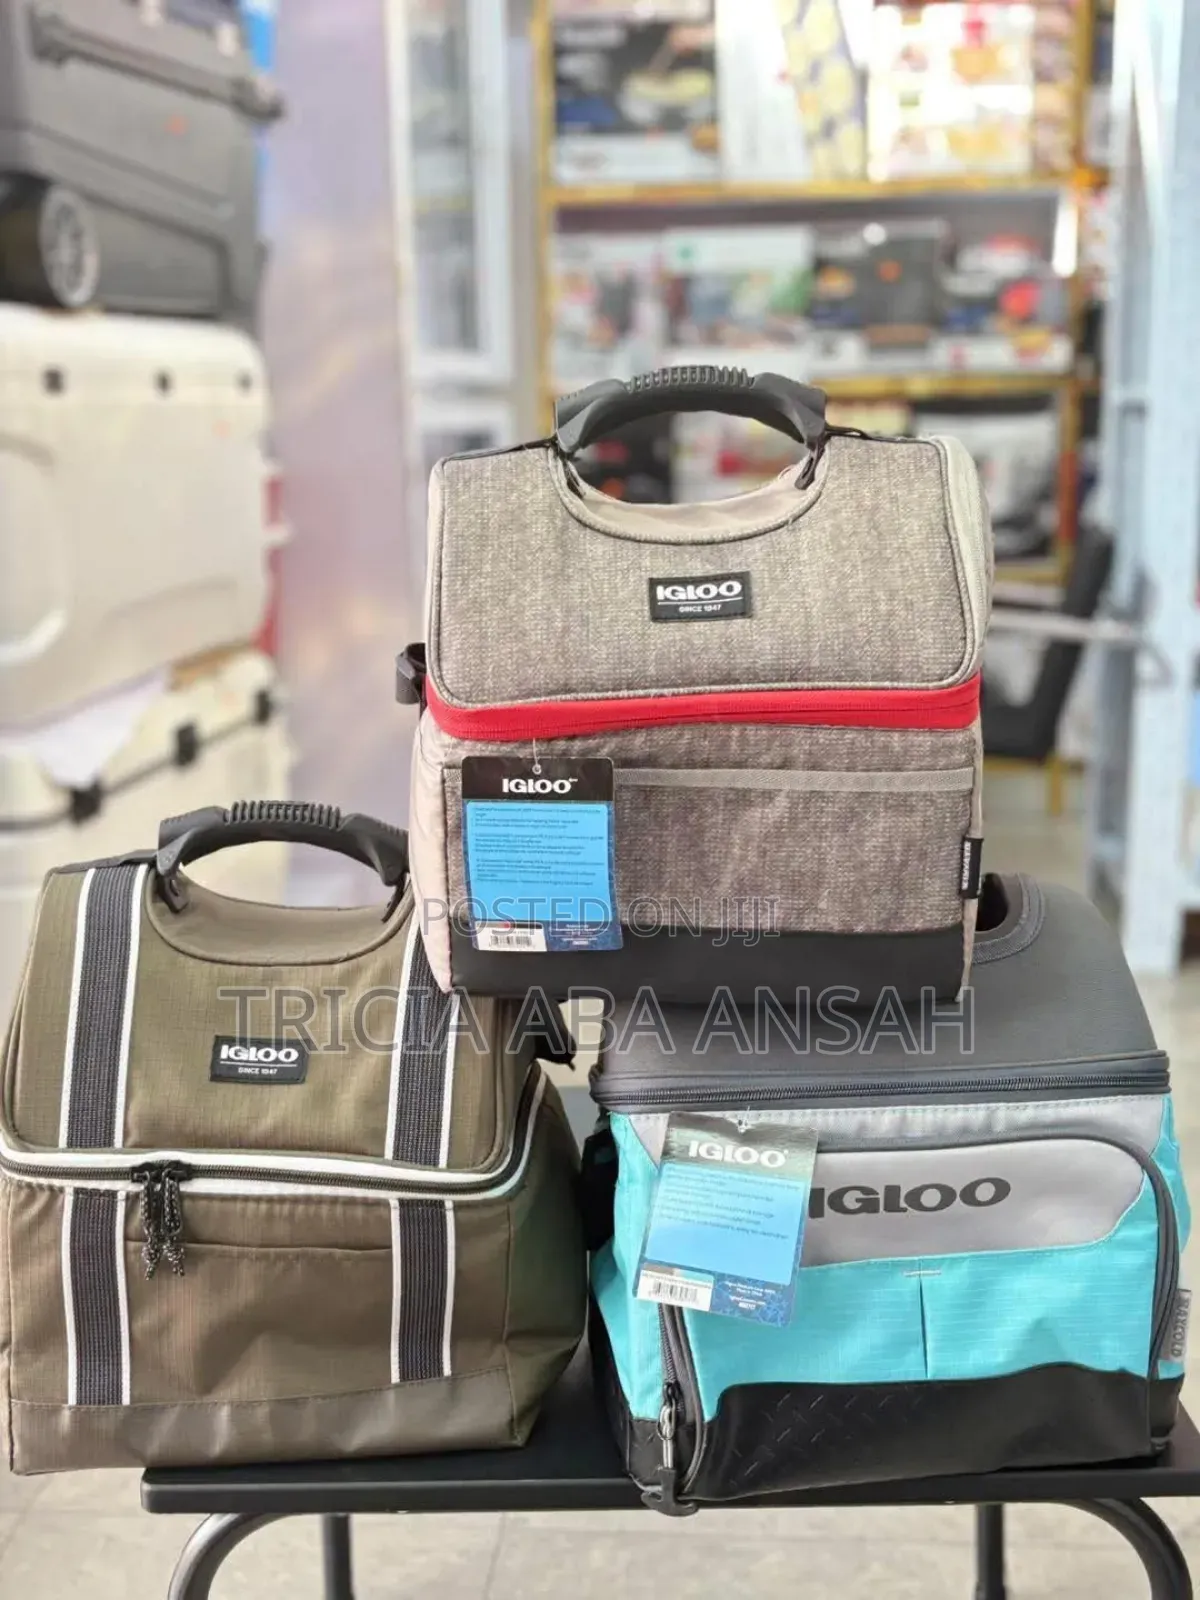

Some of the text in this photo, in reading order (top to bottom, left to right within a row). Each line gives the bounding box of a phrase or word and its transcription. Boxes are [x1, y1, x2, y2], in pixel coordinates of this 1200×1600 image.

[656, 581, 742, 600] IGLOO
[679, 603, 721, 613] SINCE 1947
[502, 778, 571, 794] IGLOO
[220, 1044, 299, 1062] IGLOO
[238, 1067, 260, 1075] SINCE
[689, 1140, 785, 1168] IGLOO
[808, 1177, 1011, 1219] IGLOO
